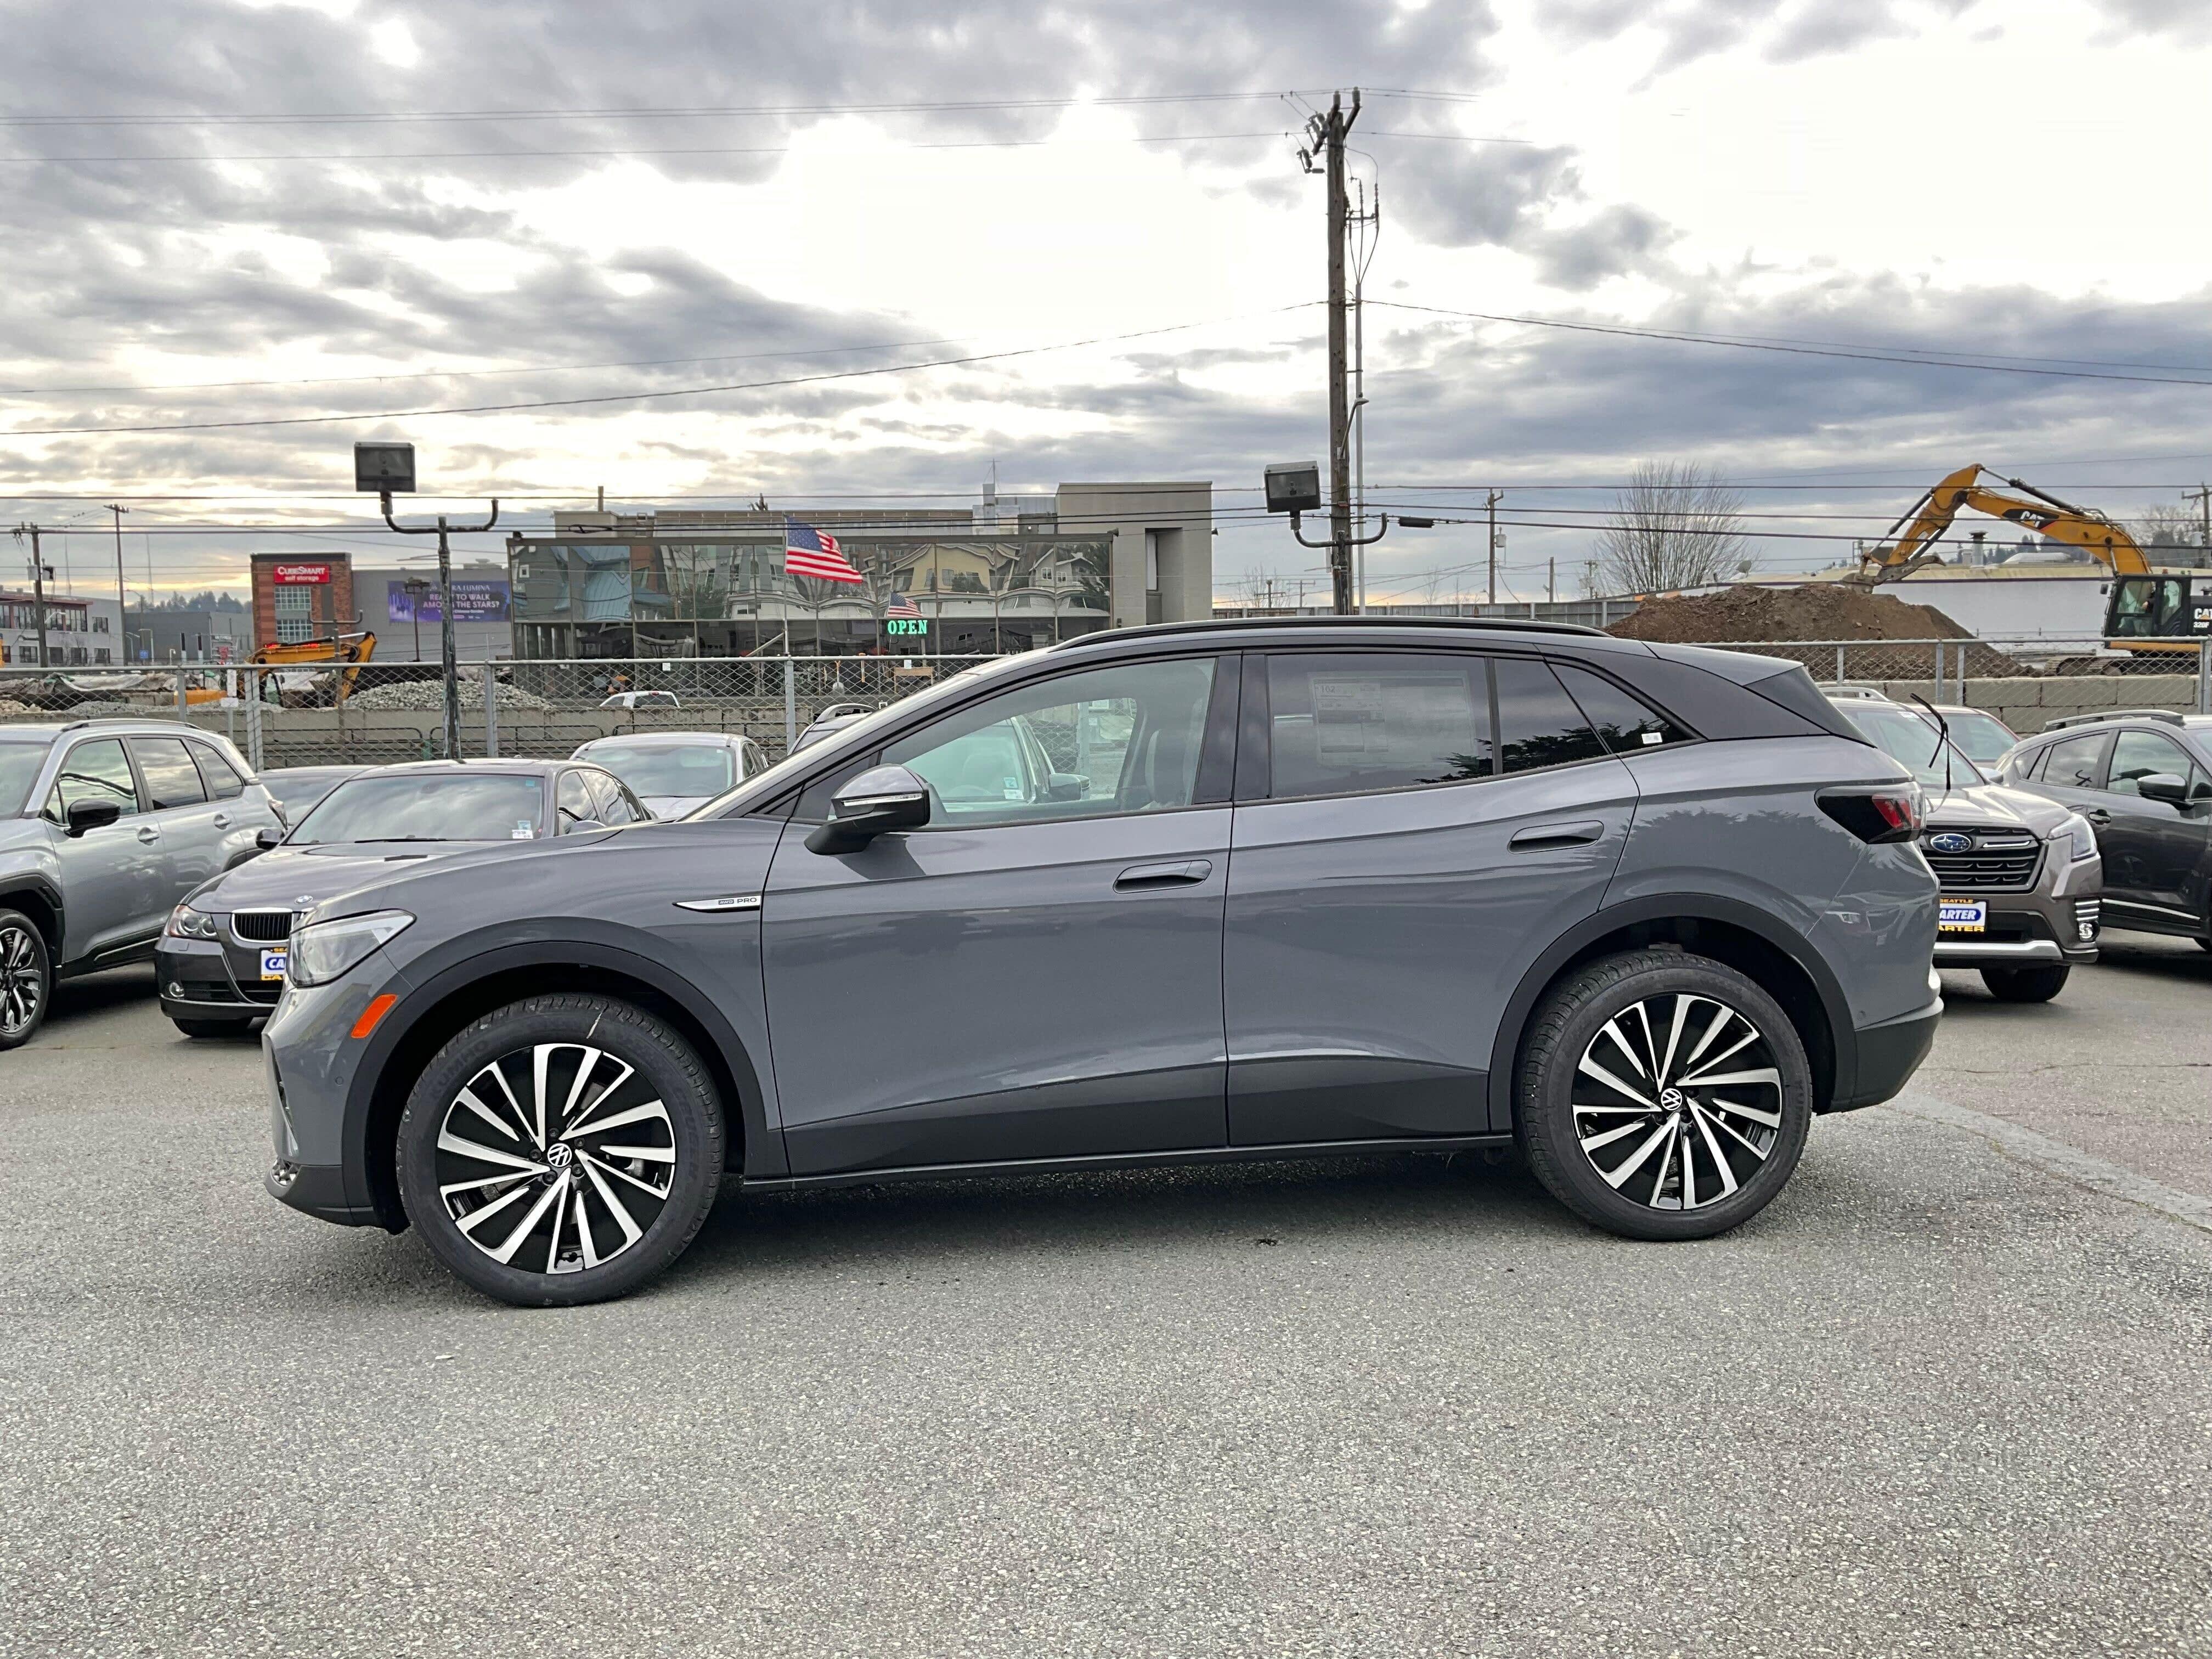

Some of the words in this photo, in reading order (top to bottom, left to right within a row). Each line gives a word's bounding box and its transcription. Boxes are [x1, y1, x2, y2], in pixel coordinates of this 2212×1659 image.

[2020, 511, 2045, 528] CAT
[888, 620, 928, 634] OPEN
[1939, 909, 1977, 919] ARTER
